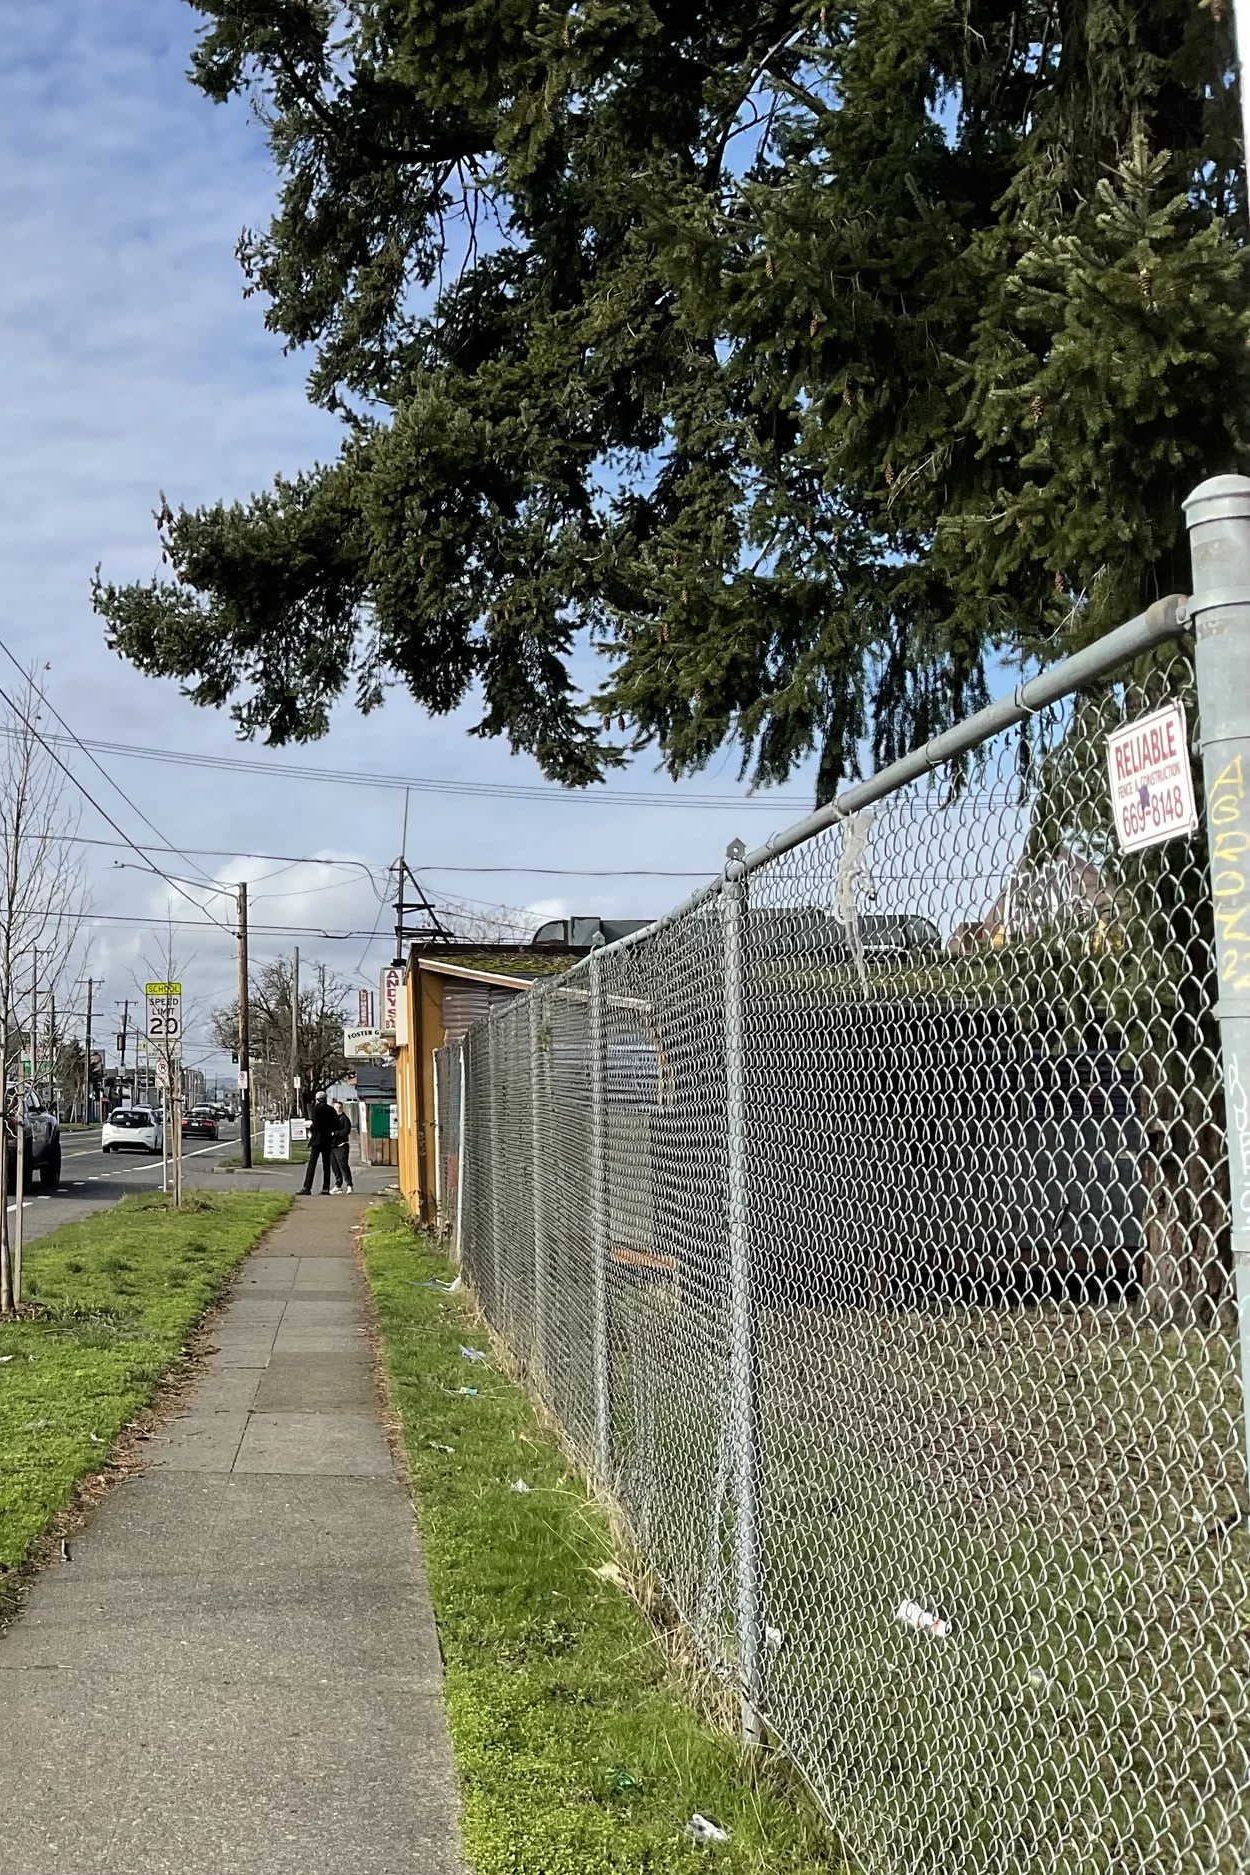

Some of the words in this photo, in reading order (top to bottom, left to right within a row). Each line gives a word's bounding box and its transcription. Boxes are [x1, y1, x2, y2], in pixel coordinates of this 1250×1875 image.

[1115, 720, 1177, 781] RELIABLE
[1140, 761, 1181, 786] CONSTRUCTION
[1122, 785, 1184, 838] 669-8148
[148, 985, 180, 993] SCHOOL
[149, 998, 179, 1006] SPEED
[150, 1017, 178, 1034] 20
[347, 1030, 373, 1040] FOSTER
